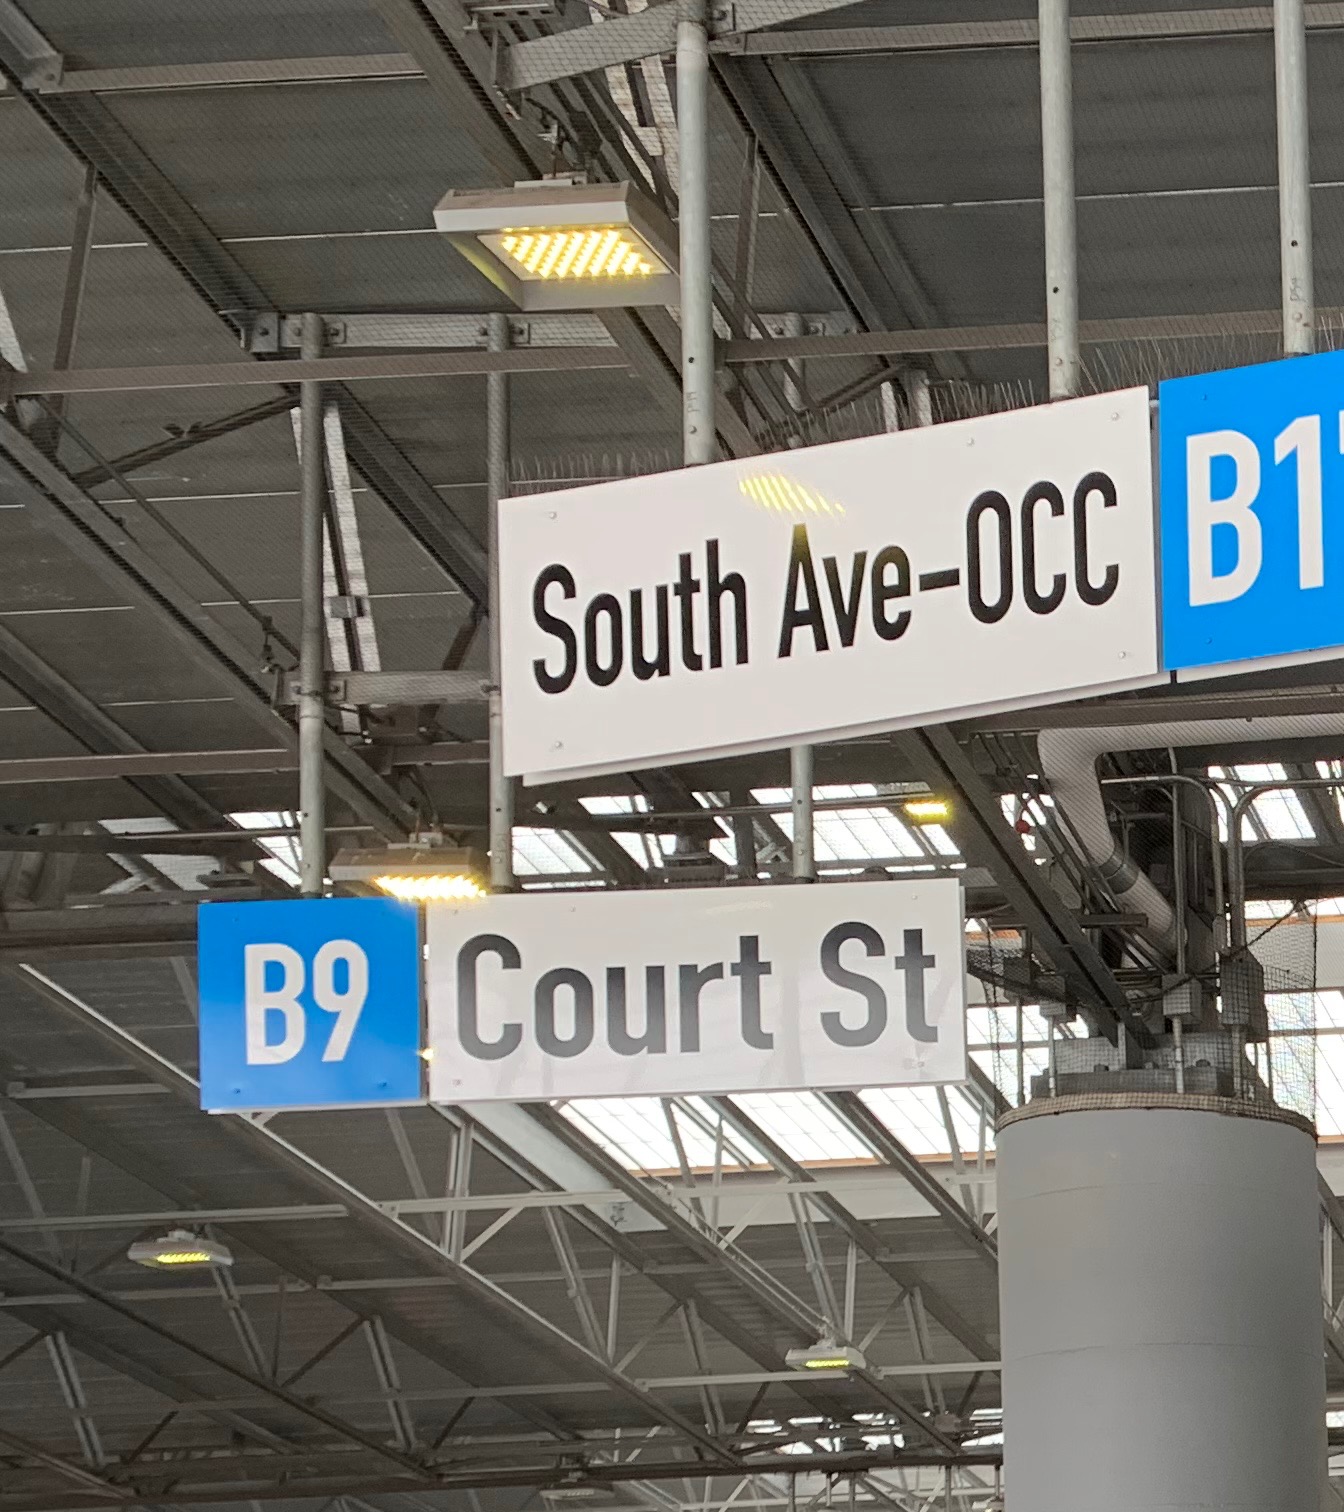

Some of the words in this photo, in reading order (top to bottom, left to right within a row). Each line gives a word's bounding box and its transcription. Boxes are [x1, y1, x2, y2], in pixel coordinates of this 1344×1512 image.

[530, 537, 750, 696] South
[777, 469, 1122, 659] Ave-OCC
[243, 938, 371, 1066] B9
[455, 932, 775, 1062] Court
[818, 919, 940, 1048] St
